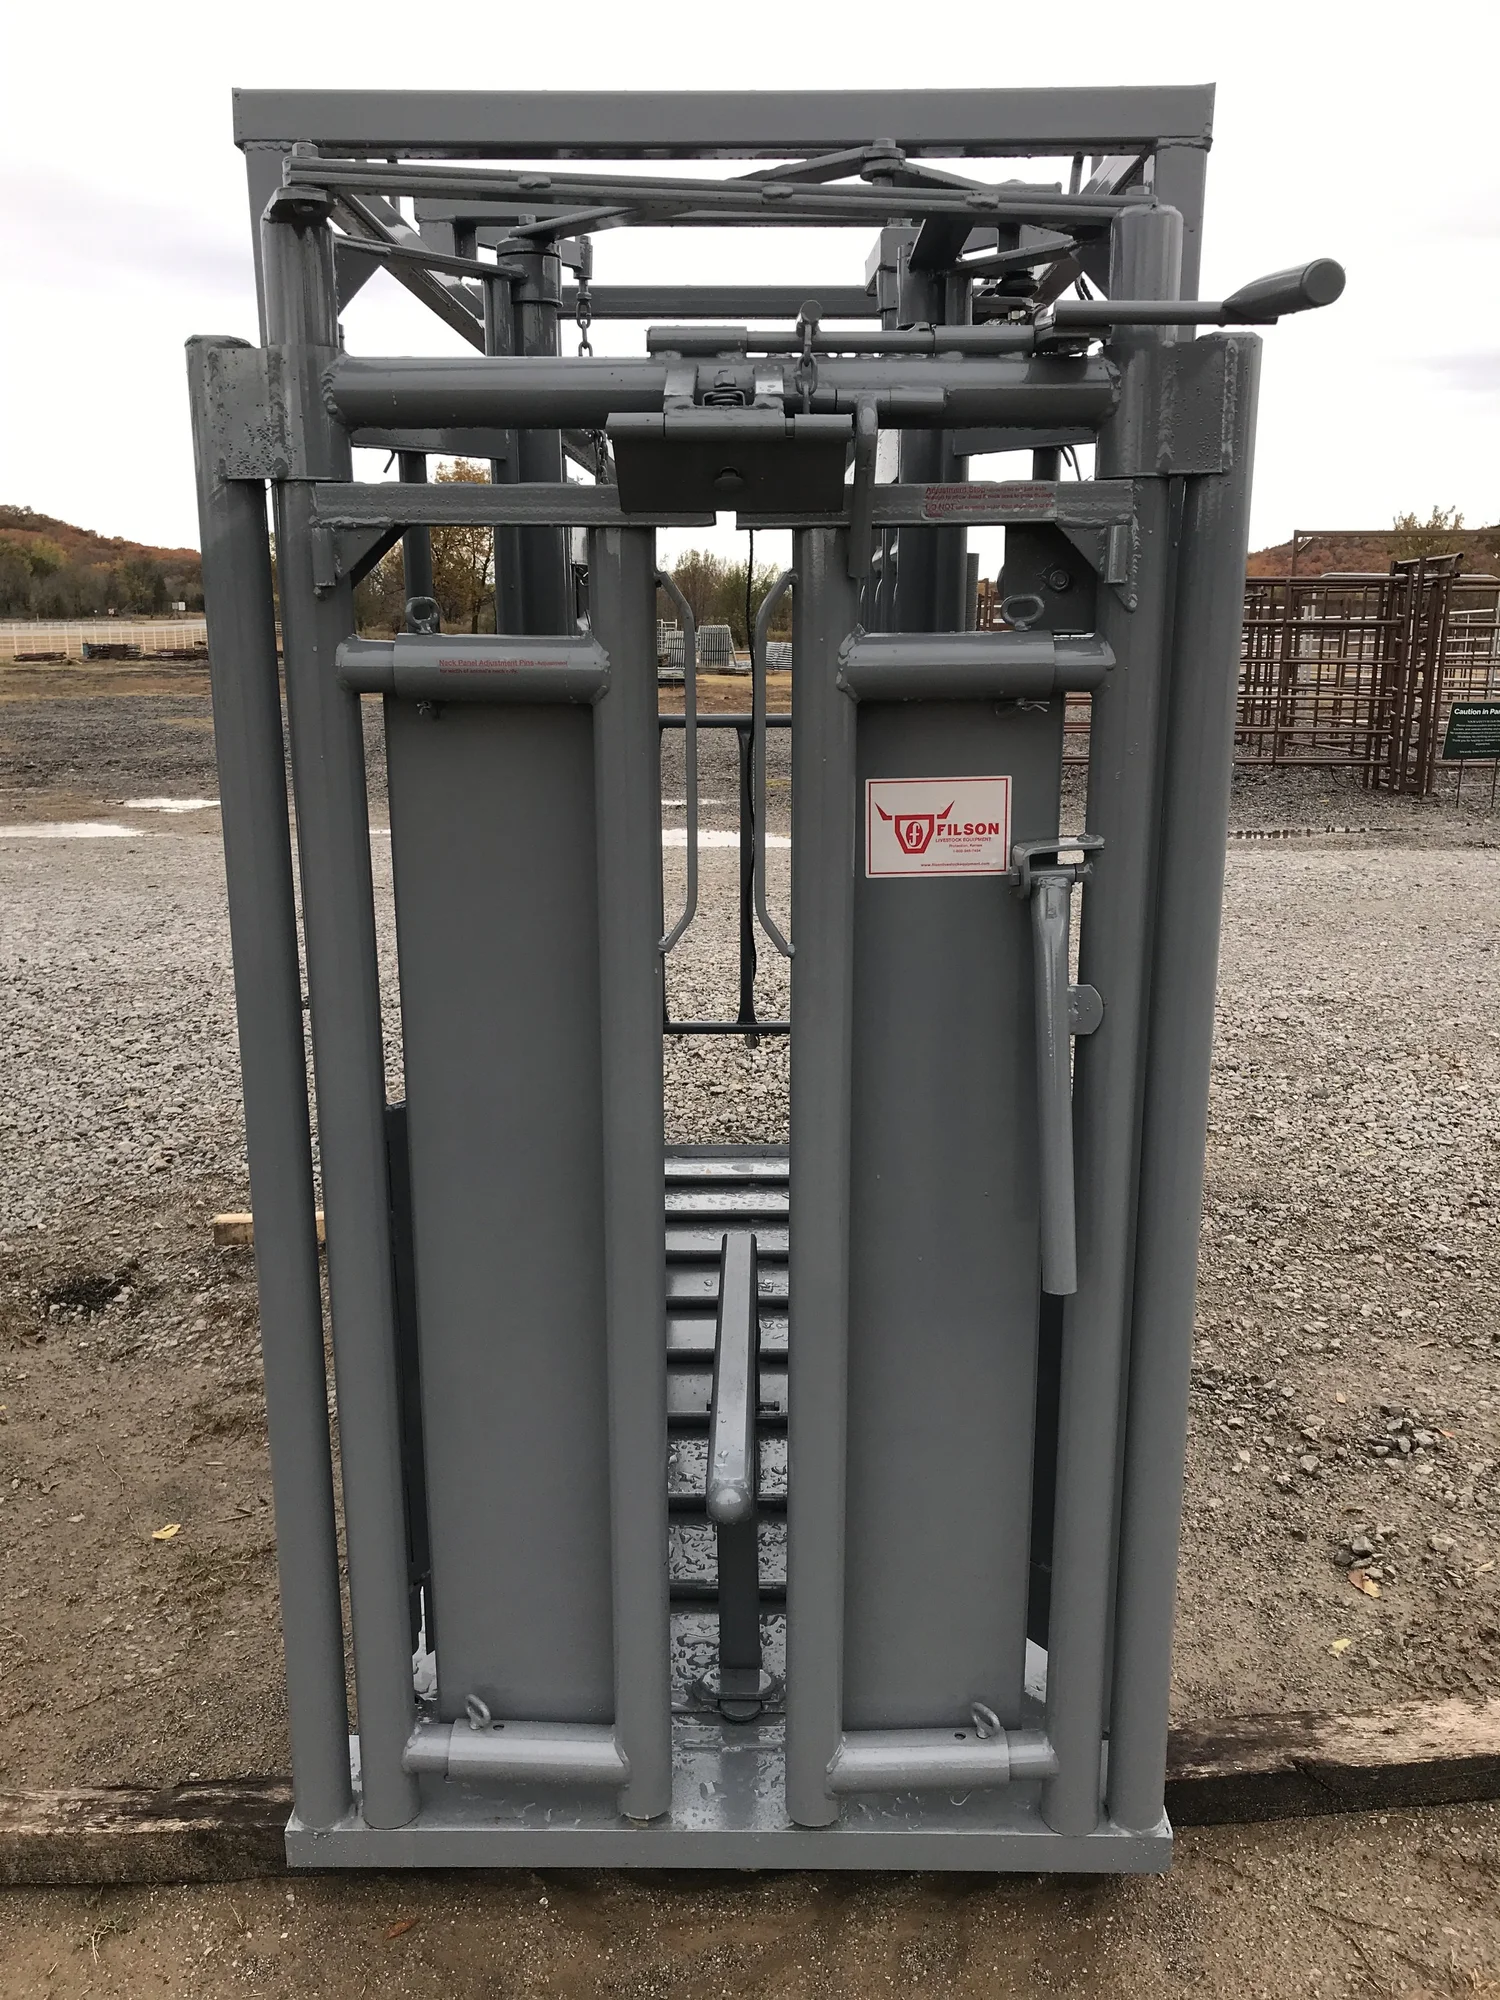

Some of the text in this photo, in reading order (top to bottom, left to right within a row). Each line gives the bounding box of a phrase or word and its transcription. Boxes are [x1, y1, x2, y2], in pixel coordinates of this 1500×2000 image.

[969, 486, 985, 494] Stop
[439, 659, 457, 667] Neck
[458, 659, 478, 667] Panel
[479, 659, 518, 668] Adjustment
[519, 659, 534, 667] Pins
[937, 823, 999, 836] FILSON
